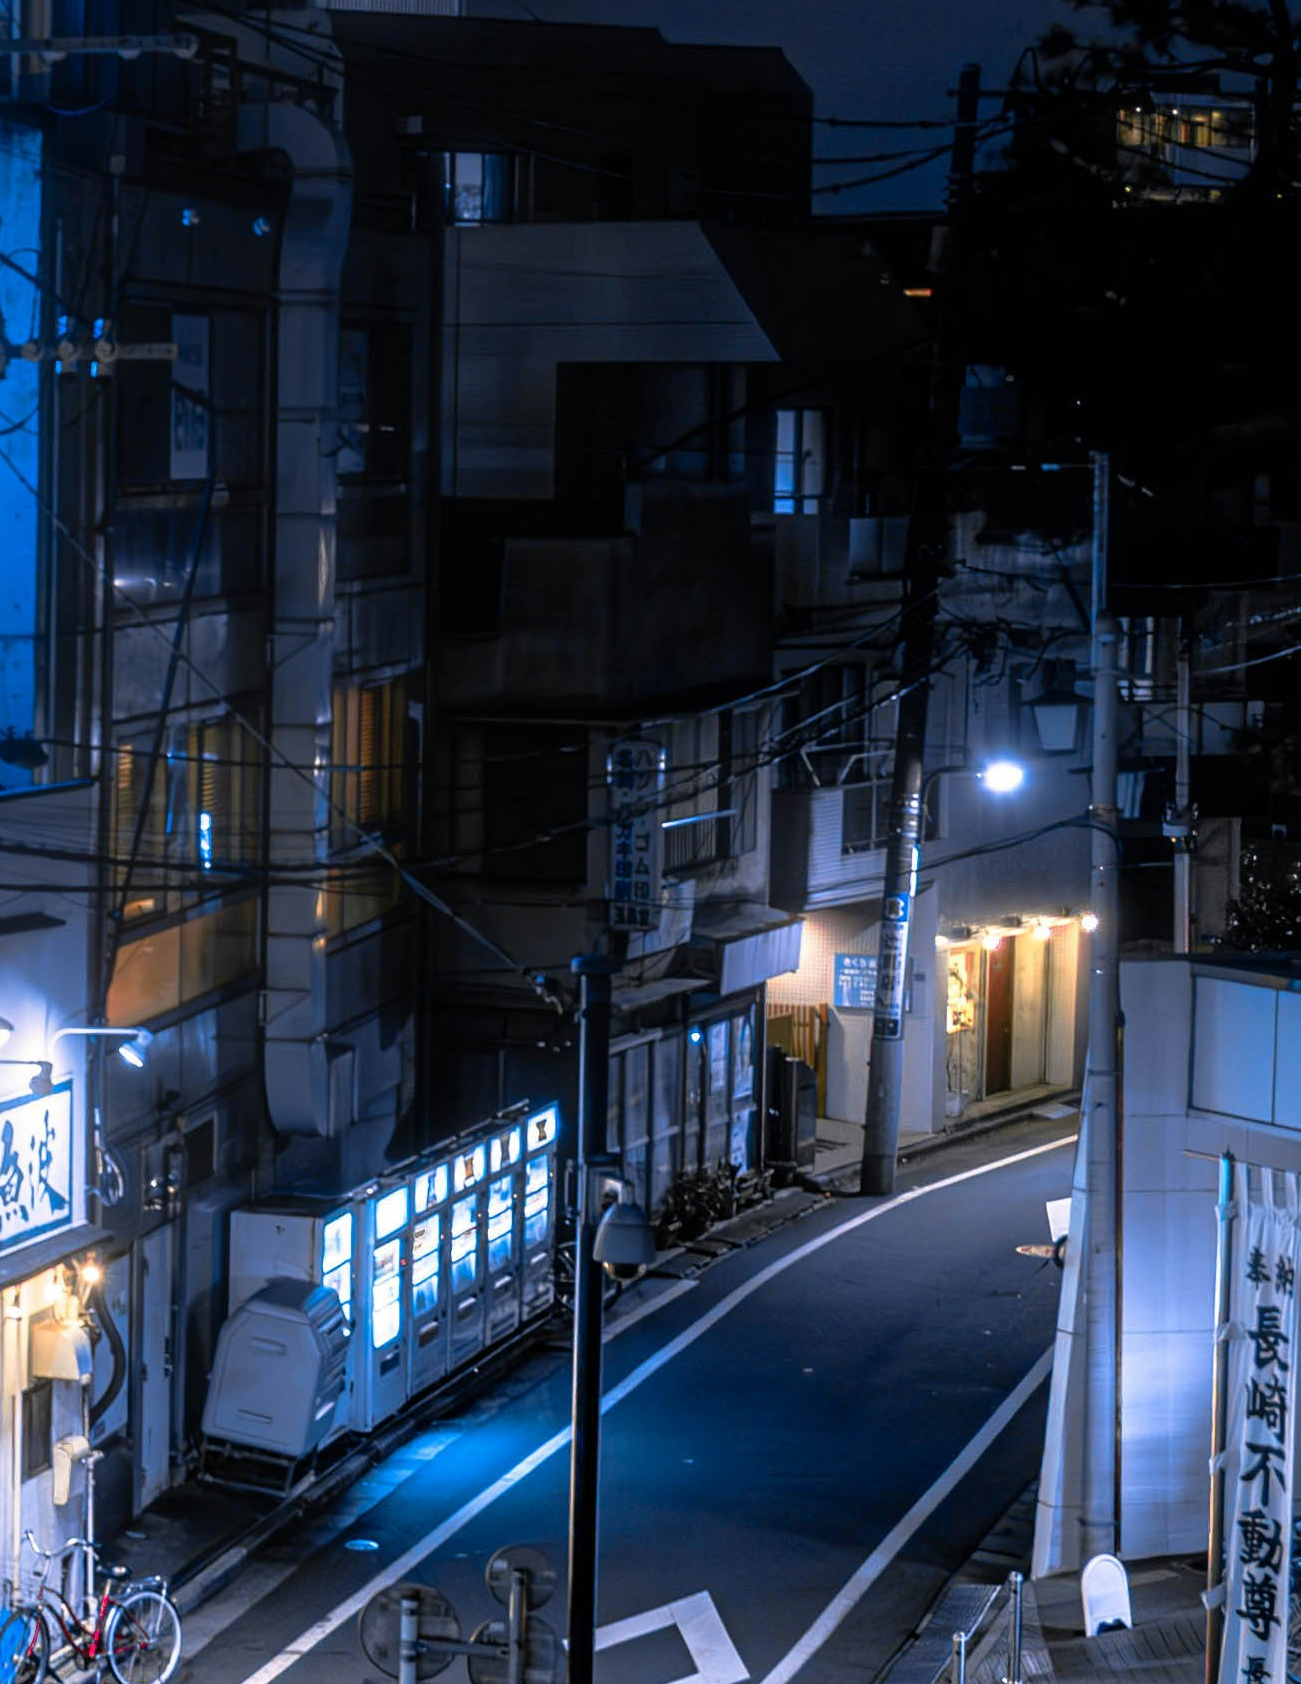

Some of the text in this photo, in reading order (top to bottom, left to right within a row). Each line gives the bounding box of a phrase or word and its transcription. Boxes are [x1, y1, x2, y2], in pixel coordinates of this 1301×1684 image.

[1236, 1303, 1291, 1643] 長崎不動尊
